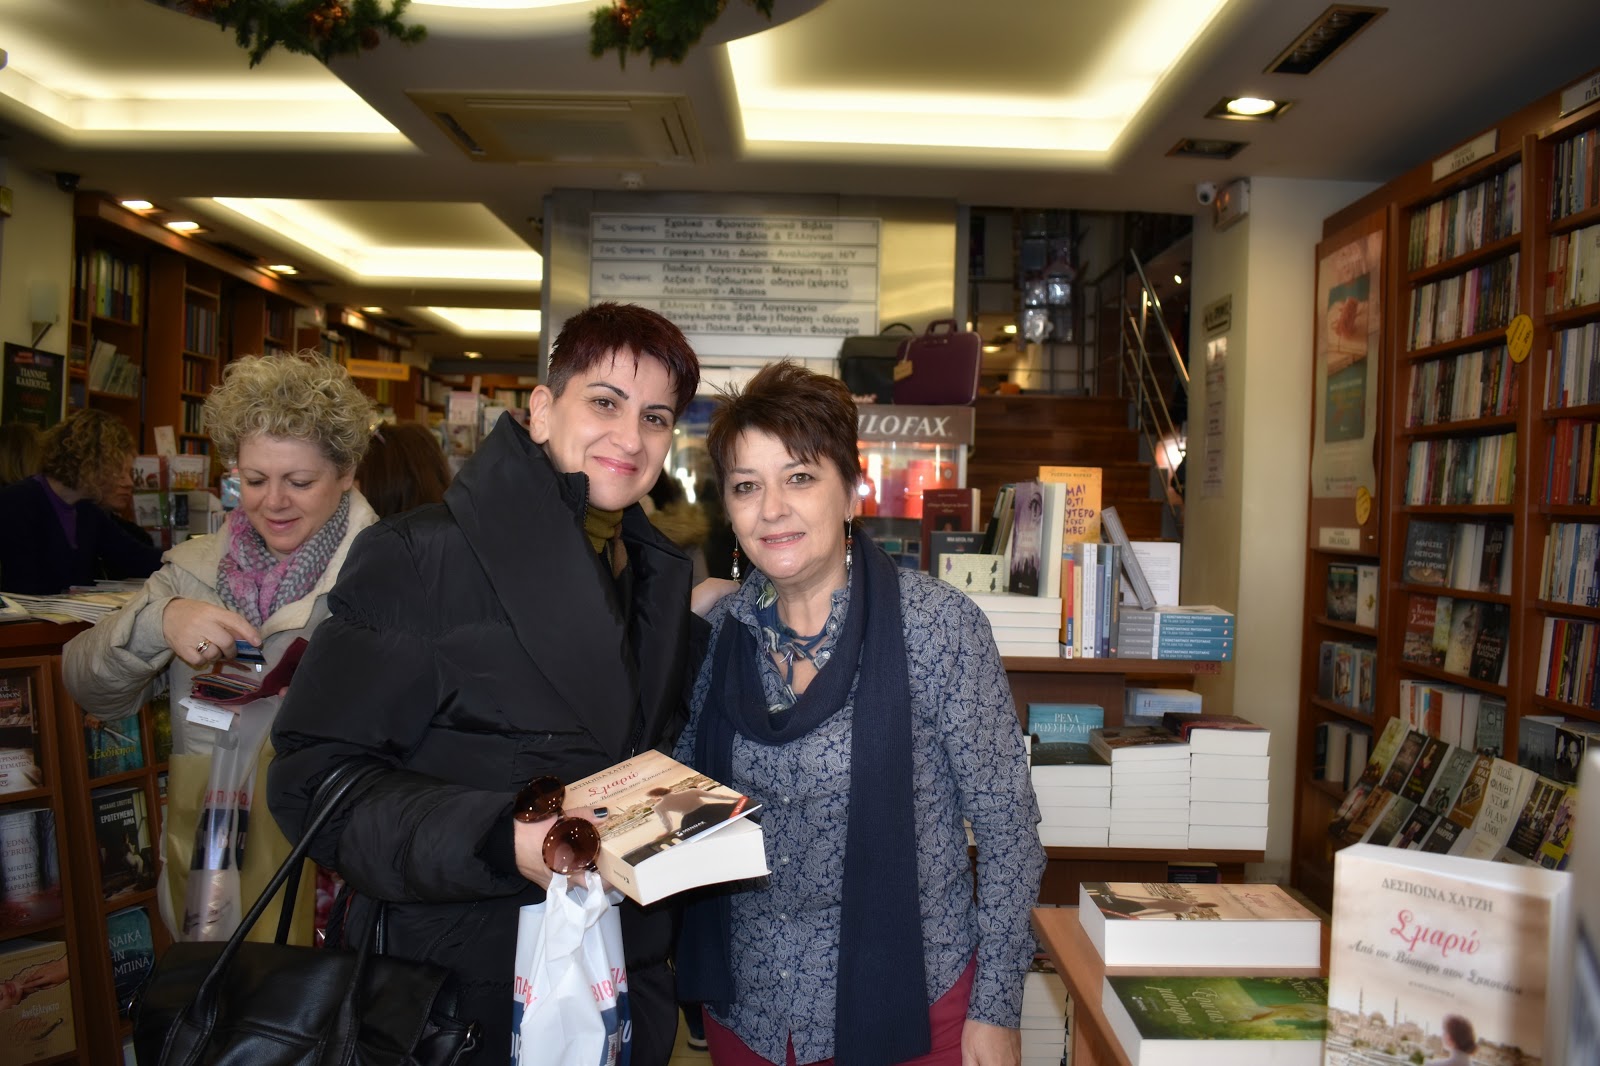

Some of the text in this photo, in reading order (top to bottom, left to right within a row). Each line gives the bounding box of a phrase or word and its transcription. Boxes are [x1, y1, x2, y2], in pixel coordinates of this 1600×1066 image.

[728, 287, 766, 296] Albums
[857, 414, 951, 437] ILOFAX
[1066, 484, 1086, 498] ΜΑΙ
[1066, 508, 1095, 519] ΥΤΕΡΟ
[1065, 526, 1087, 536] ΜΒΕΙ
[1054, 713, 1079, 723] ΡΕΝΑ
[1487, 711, 1503, 727] CH
[6, 838, 30, 848] EDNA
[1381, 877, 1494, 912] ΔΕΣΠΟΙΝΑ ΧΑΤΖΗ
[108, 929, 143, 949] ΝΑΙΚΑ
[1390, 908, 1481, 958] Σμαρώ
[114, 956, 151, 977] ΜΠΙΝΑ
[1348, 939, 1374, 955] Από
[1392, 950, 1441, 975] Βόσπορο
[1442, 966, 1464, 980] στον
